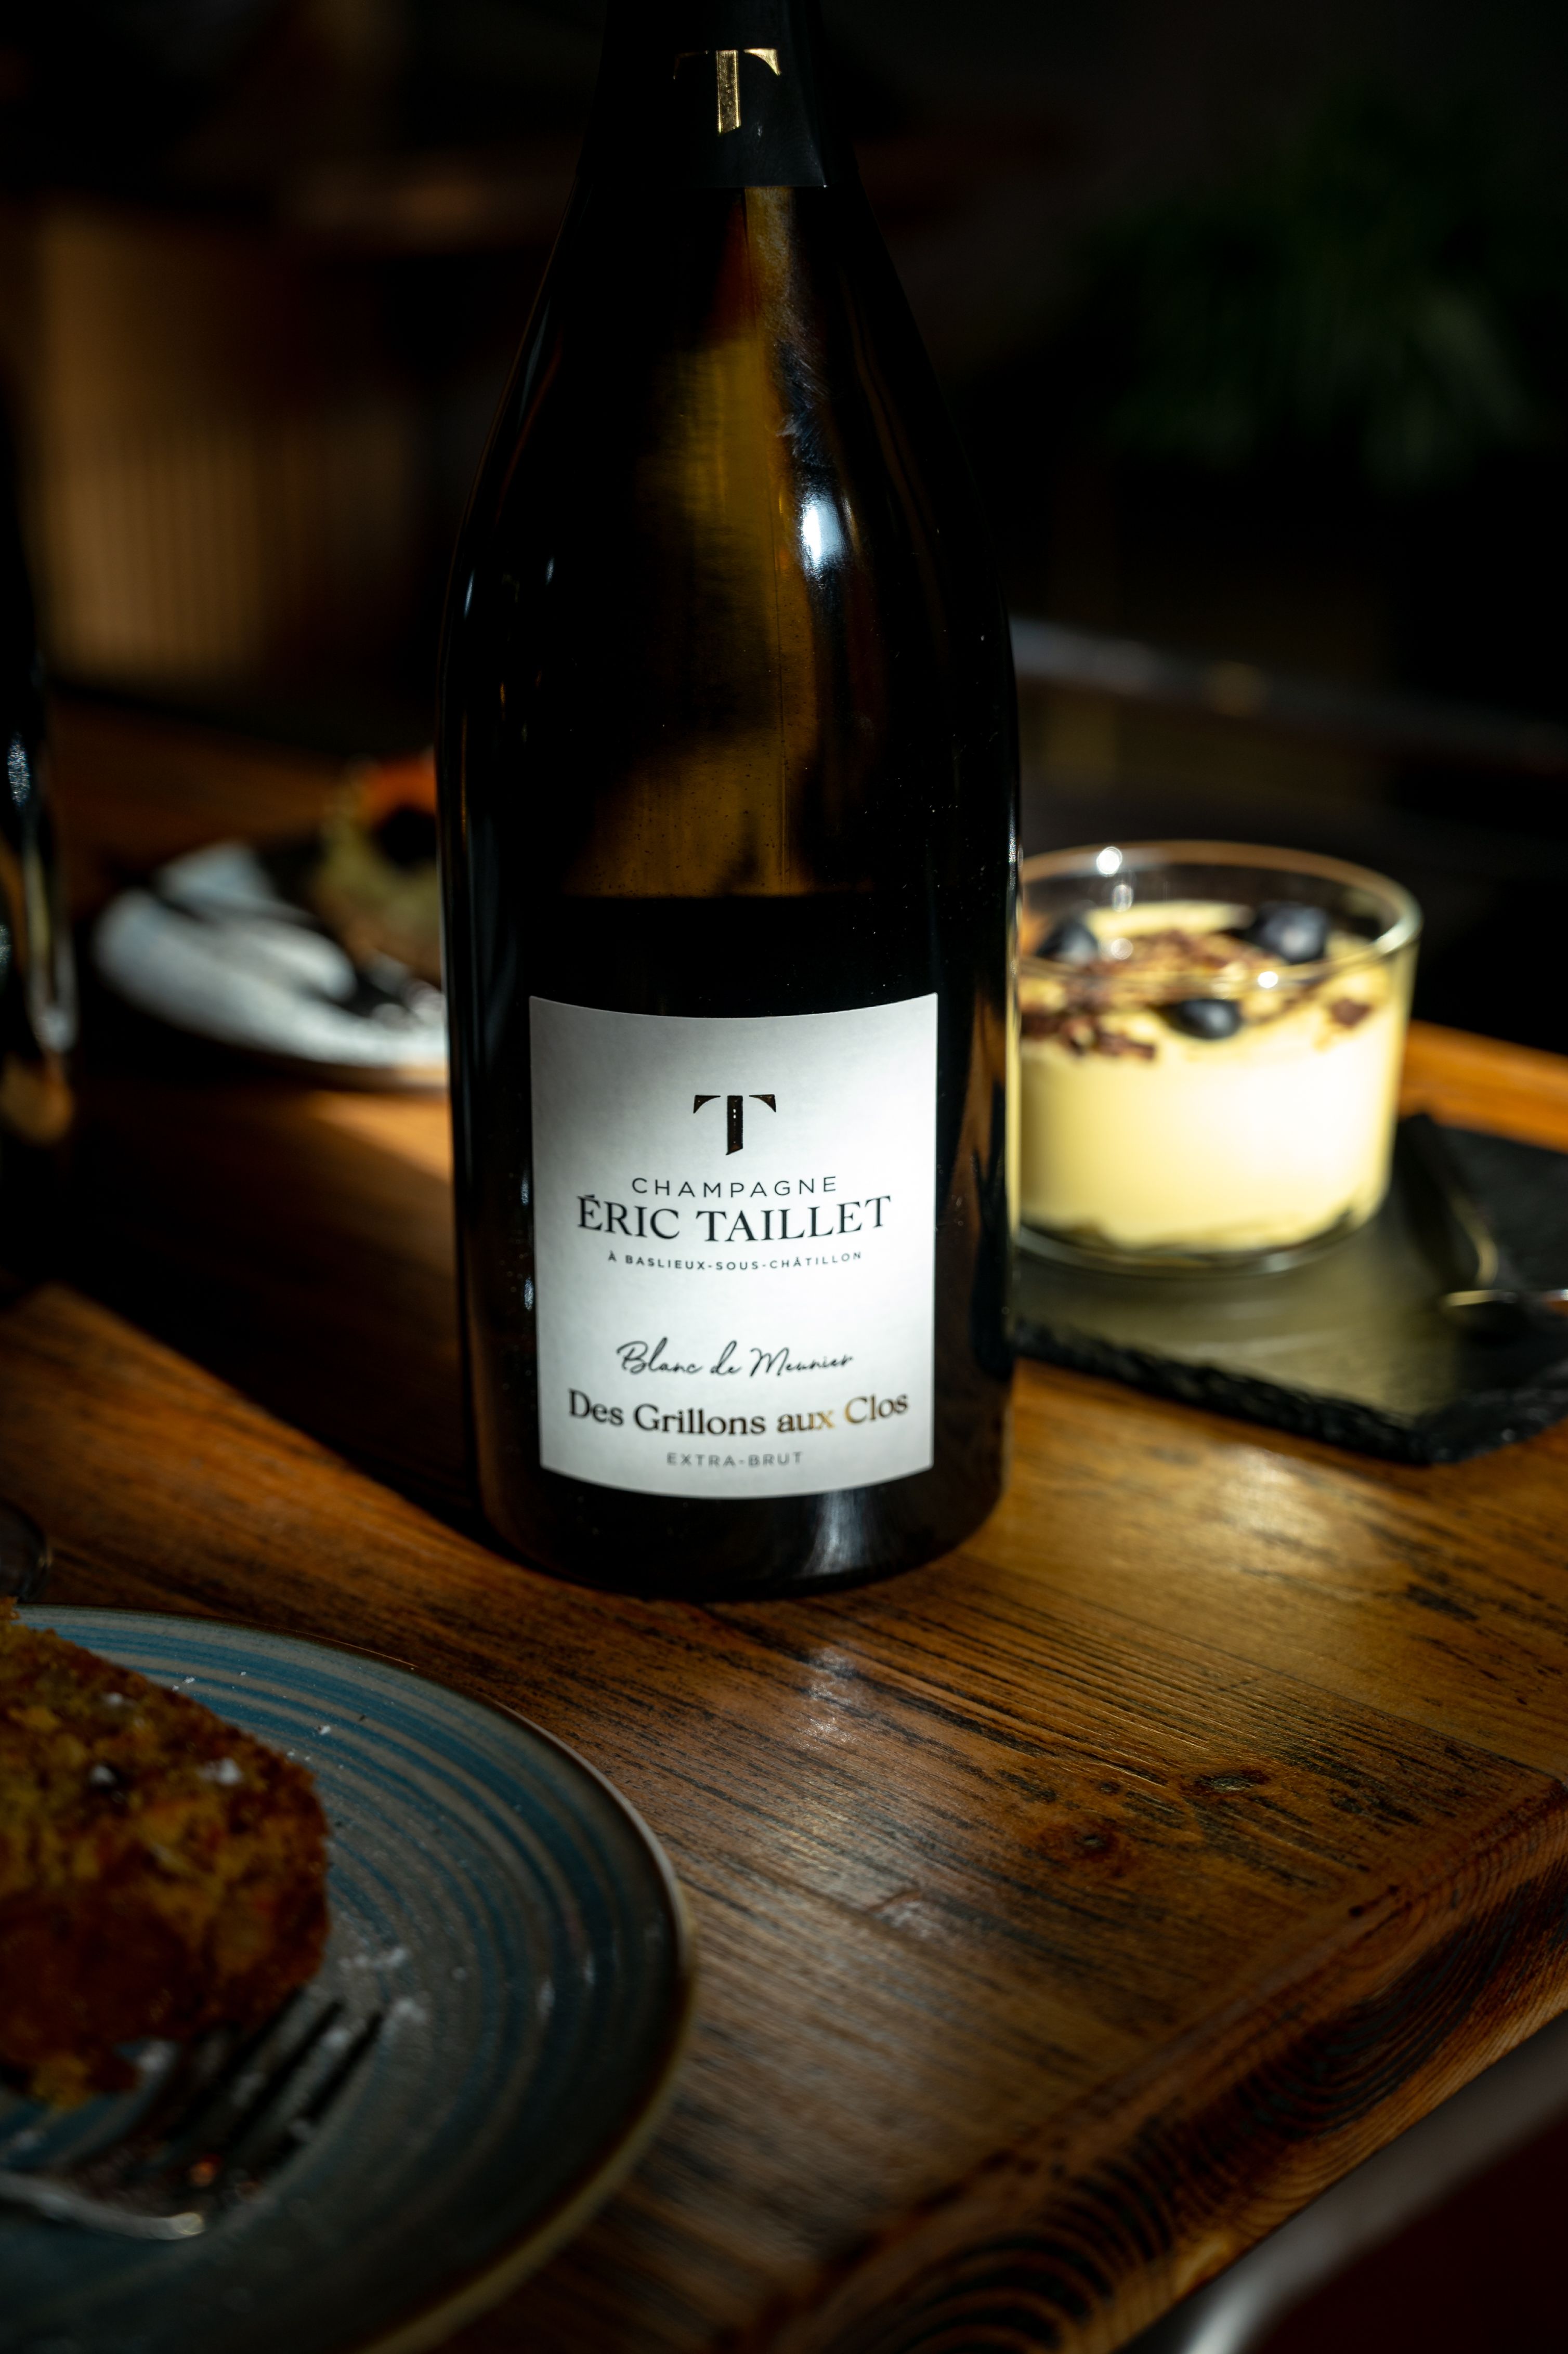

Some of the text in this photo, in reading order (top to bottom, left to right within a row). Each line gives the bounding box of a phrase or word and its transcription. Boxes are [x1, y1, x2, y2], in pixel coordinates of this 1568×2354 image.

[673, 48, 781, 137] T
[693, 1094, 776, 1156] T
[632, 1176, 837, 1198] CHAMPAGNE
[577, 1194, 892, 1242] ÉRIC TAILLET
[608, 1250, 862, 1271] À BASLIEUX-SOUS-CHÂTILLON
[616, 1336, 854, 1378] Blanc de Meunier
[568, 1388, 910, 1436] Des Grillons aux Clos
[667, 1450, 802, 1468] EXTRA-BRUT
